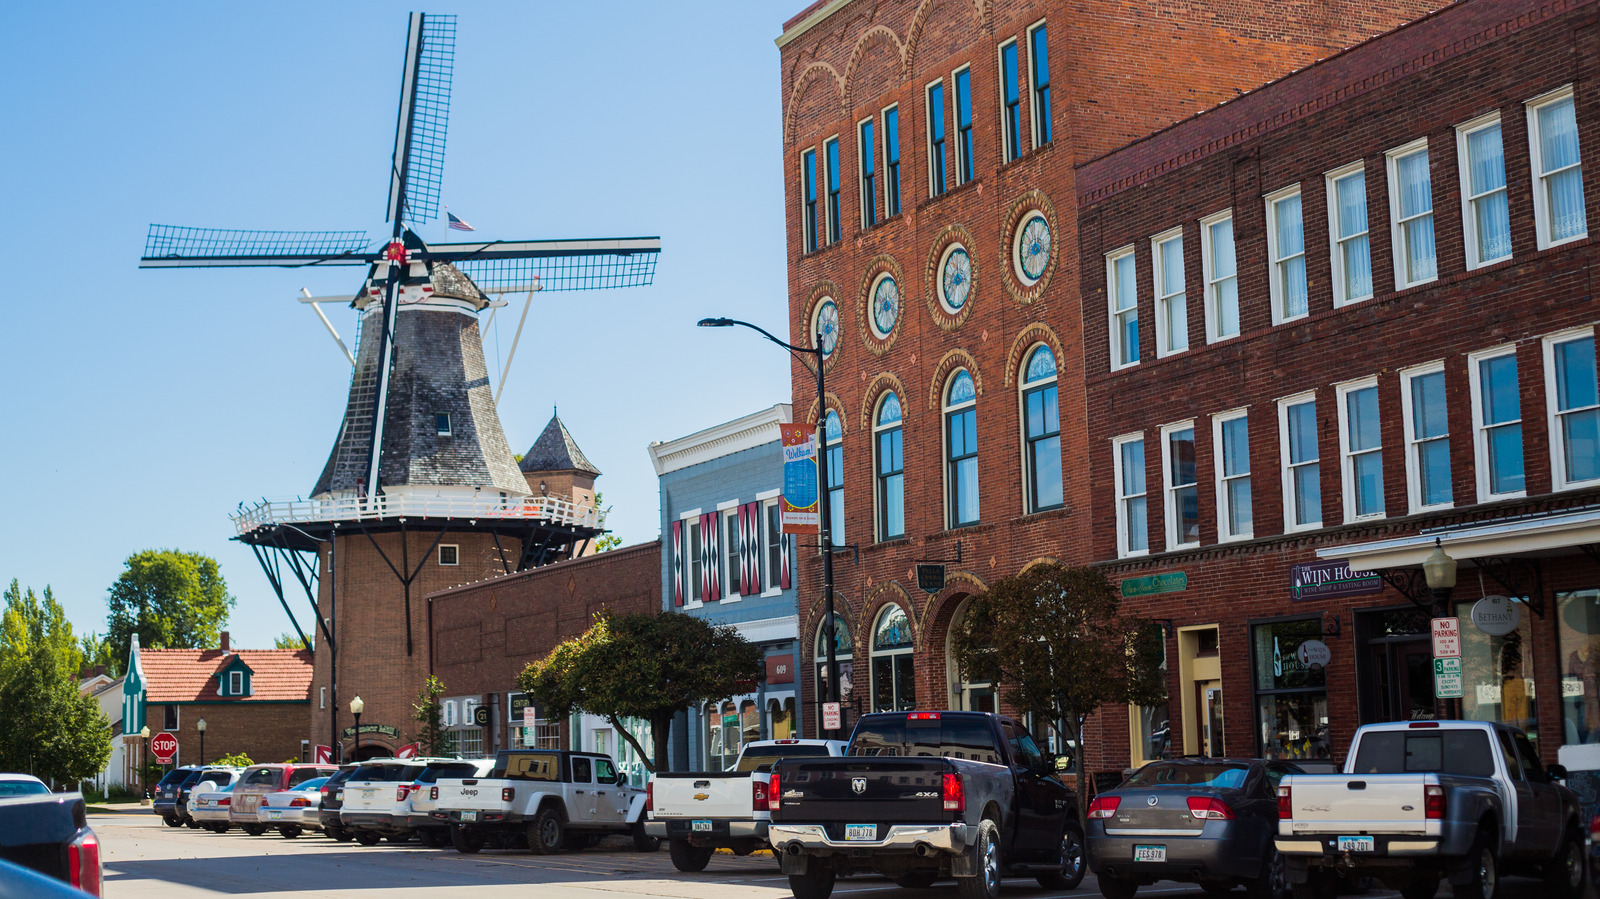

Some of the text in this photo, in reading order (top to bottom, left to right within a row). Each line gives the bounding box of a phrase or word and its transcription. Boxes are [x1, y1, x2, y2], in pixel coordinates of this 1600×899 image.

[785, 444, 813, 460] Welkom!
[1302, 568, 1330, 587] WIJN
[1318, 584, 1332, 592] SHOP
[1339, 580, 1361, 589] TASTING
[1362, 579, 1378, 587] ROOM
[776, 665, 787, 674] 609
[1283, 661, 1306, 671] HOUS
[1436, 662, 1442, 672] 3
[345, 725, 378, 736] Vemeer
[154, 741, 175, 751] STOP
[460, 787, 479, 797] Jeep
